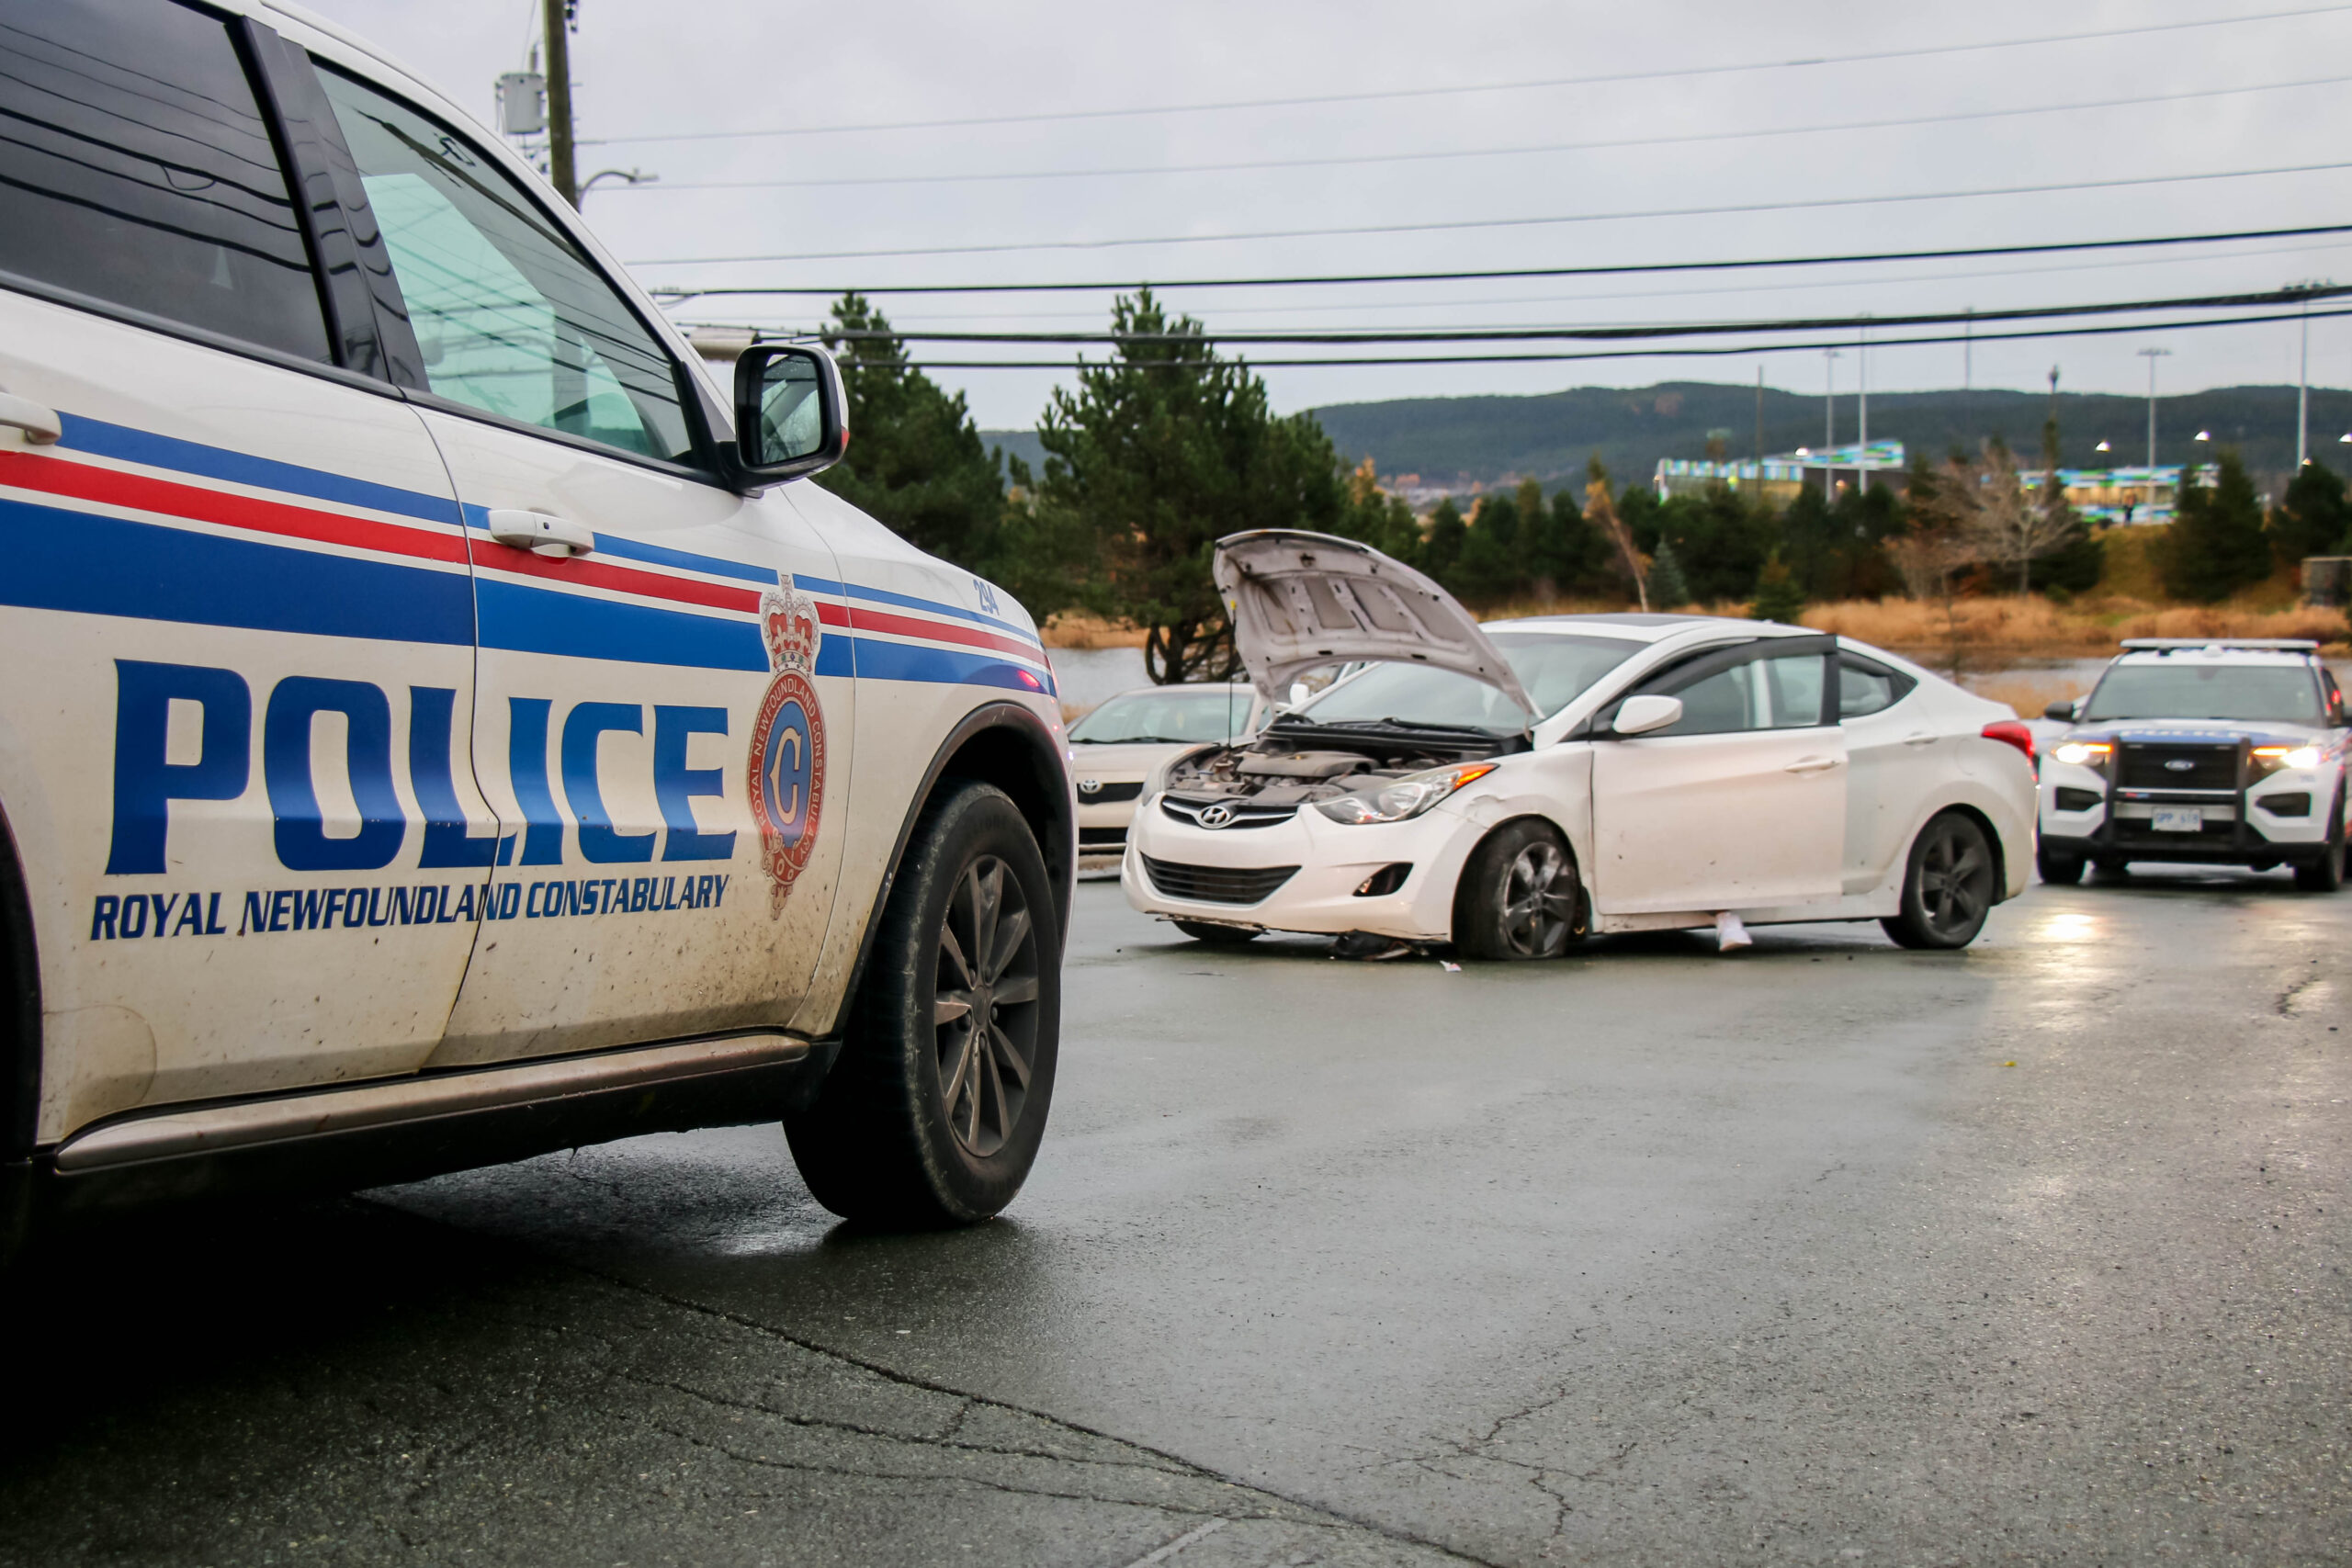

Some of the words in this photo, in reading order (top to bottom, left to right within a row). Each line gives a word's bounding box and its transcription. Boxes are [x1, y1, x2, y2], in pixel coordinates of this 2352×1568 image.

[754, 678, 816, 756] NEWFOUNDLAND
[106, 659, 737, 874] POLICE
[752, 764, 767, 827] ROYAL
[799, 721, 823, 859] CONSTABULARY
[90, 894, 227, 940] ROYAL
[243, 882, 523, 933] NEWFOUNDLAND
[526, 874, 729, 918] CONSTABULARY
